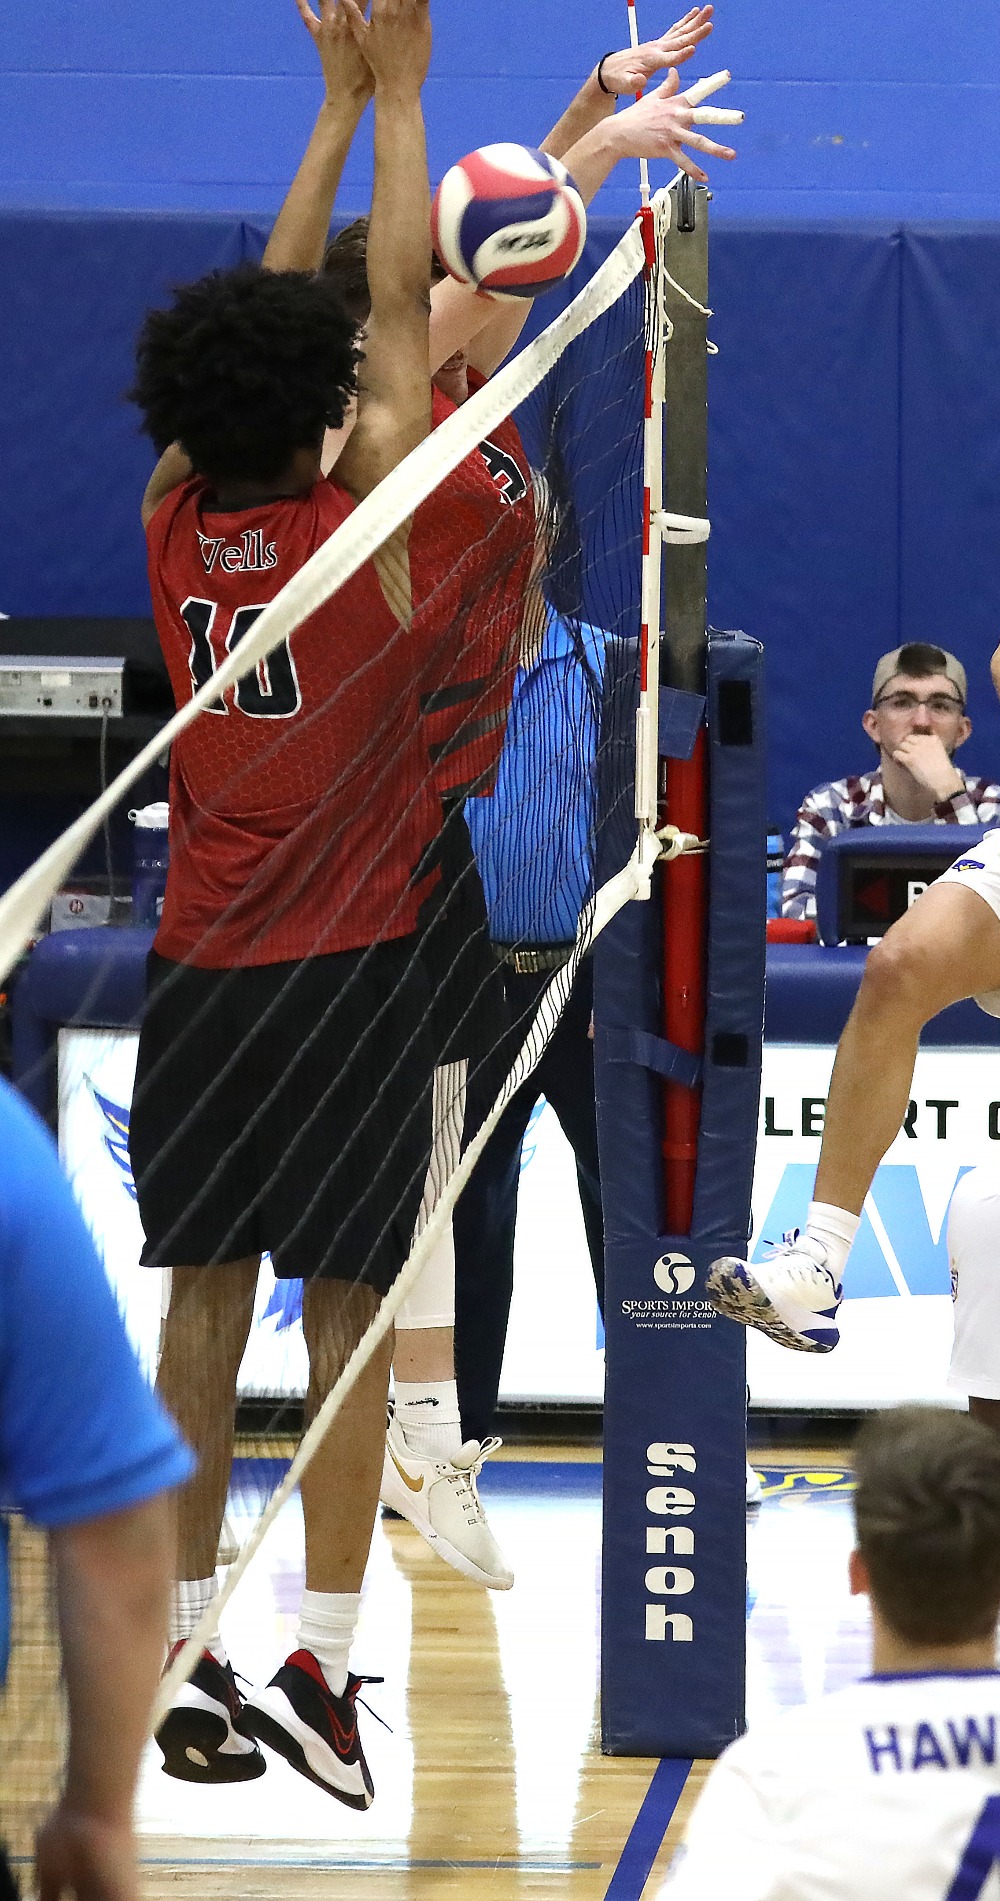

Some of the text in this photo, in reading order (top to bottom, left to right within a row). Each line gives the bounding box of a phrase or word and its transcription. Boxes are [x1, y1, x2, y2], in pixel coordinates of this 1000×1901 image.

[180, 595, 302, 719] 10
[621, 1300, 713, 1315] SPORTS IMPOR
[630, 1309, 717, 1320] your source for Senoh
[635, 1322, 712, 1330] www.sportsimports.com
